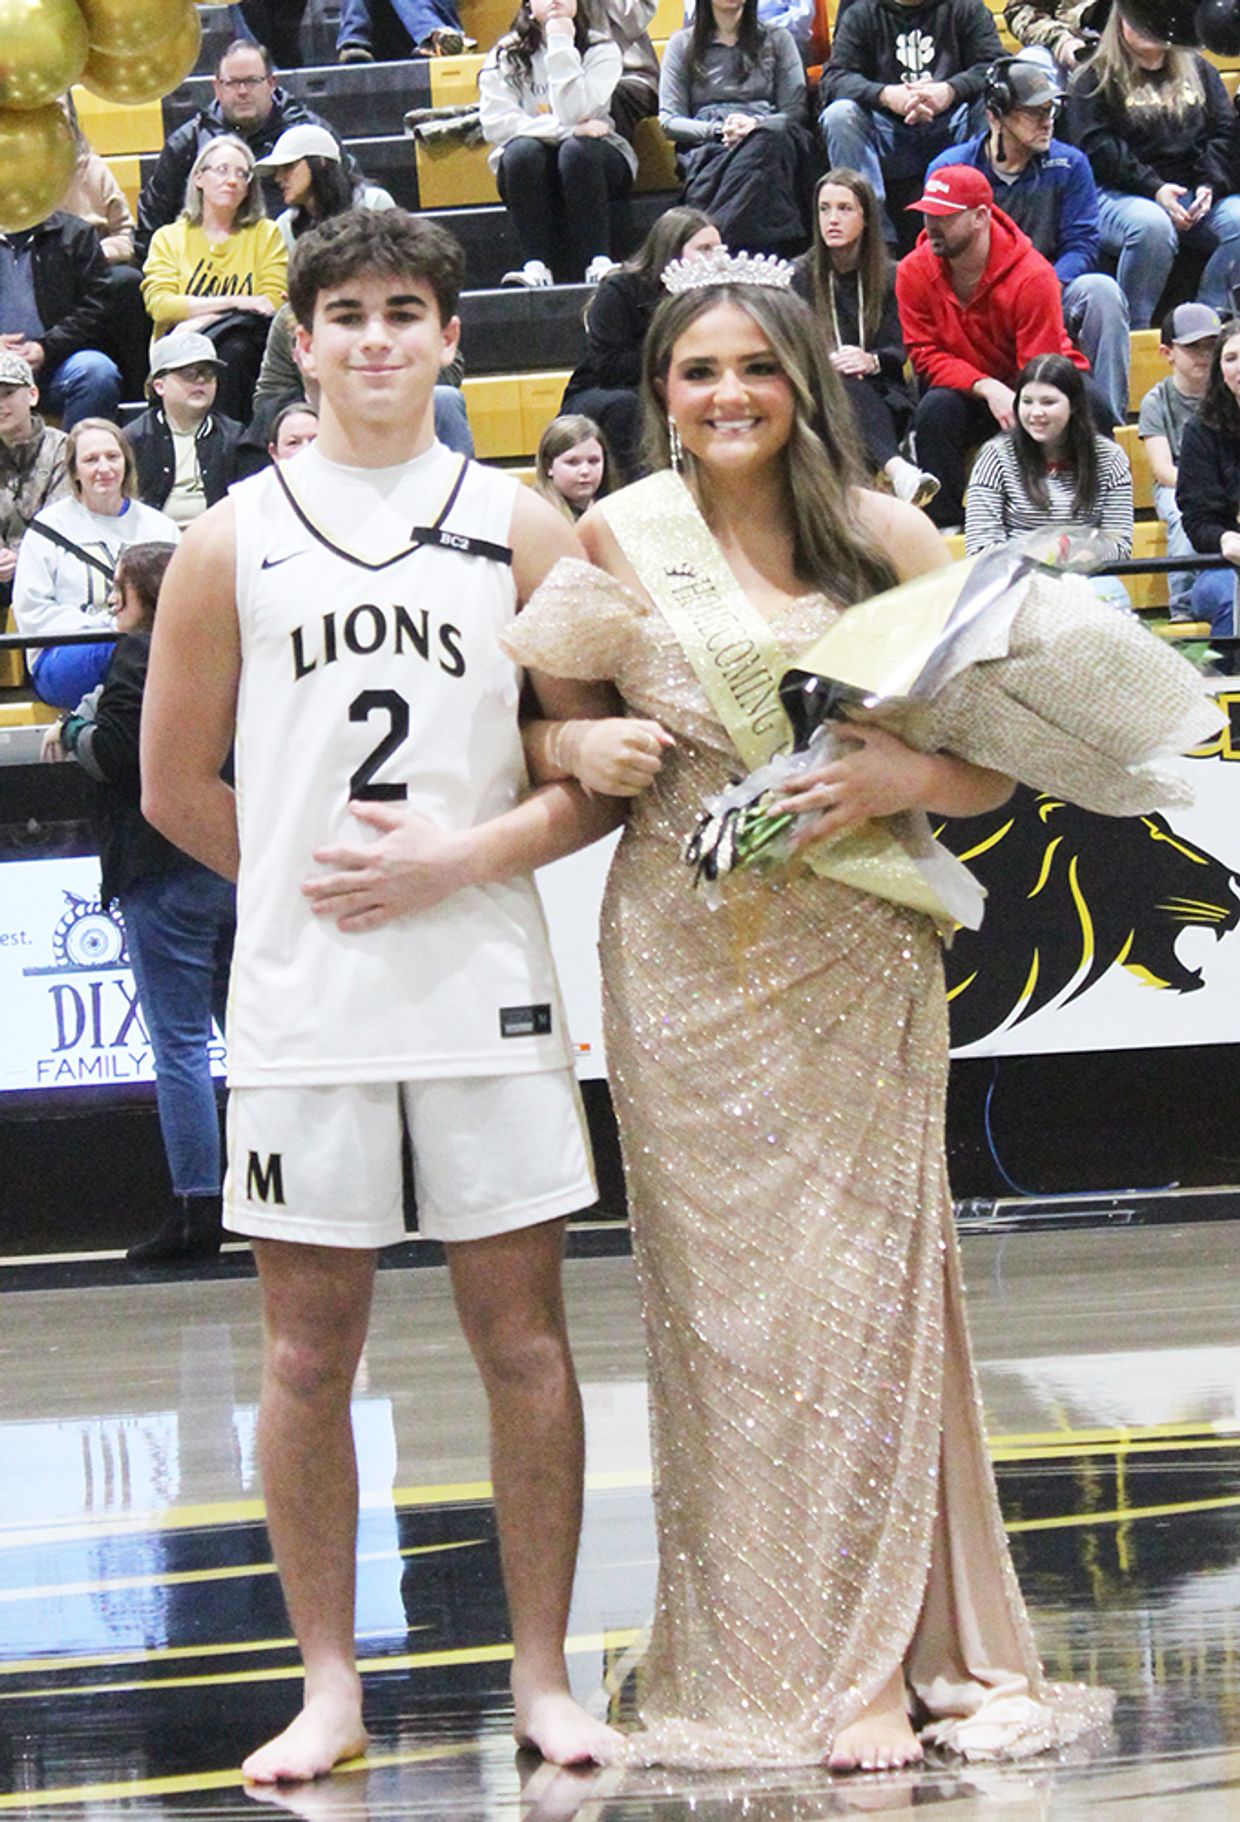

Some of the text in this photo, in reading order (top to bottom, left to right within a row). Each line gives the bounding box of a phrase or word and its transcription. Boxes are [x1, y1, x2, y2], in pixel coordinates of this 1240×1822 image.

[289, 603, 466, 682] LIONS
[348, 689, 410, 802] 2
[48, 979, 150, 1053] DIX
[37, 1051, 148, 1083] FAMILY
[246, 1150, 286, 1206] M
